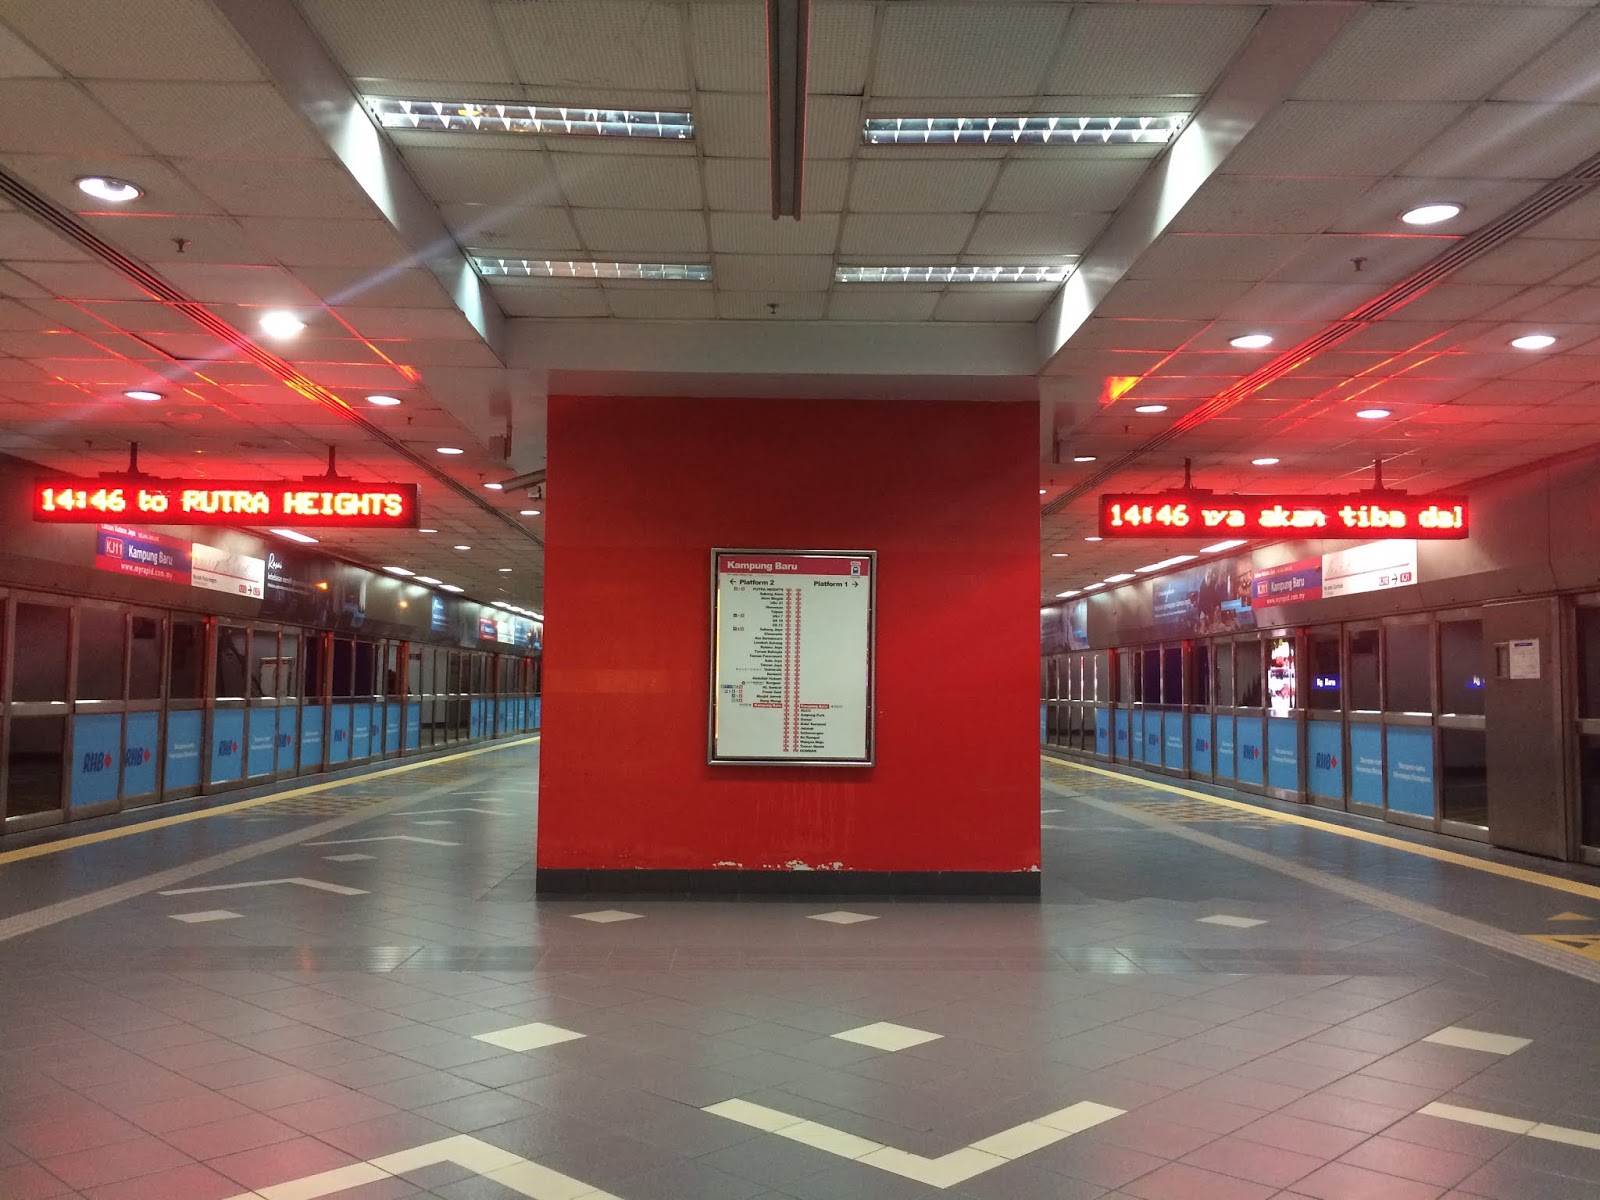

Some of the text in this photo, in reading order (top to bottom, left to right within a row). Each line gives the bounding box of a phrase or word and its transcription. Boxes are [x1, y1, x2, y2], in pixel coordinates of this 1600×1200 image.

[42, 488, 126, 512] 14:46
[138, 489, 169, 512] to
[283, 491, 403, 516] HEIGHTS
[1110, 504, 1190, 526] 14:46
[1258, 505, 1327, 528] akan
[1338, 505, 1406, 528] tiba
[106, 540, 123, 556] KJ11
[128, 544, 173, 566] Kampung Baru
[120, 562, 173, 580] www.myrapid.com.my
[727, 560, 798, 572] Kampung Baru
[1271, 577, 1305, 593] Kampung Baru
[83, 752, 105, 774] RHB
[1315, 752, 1331, 770] RHB
